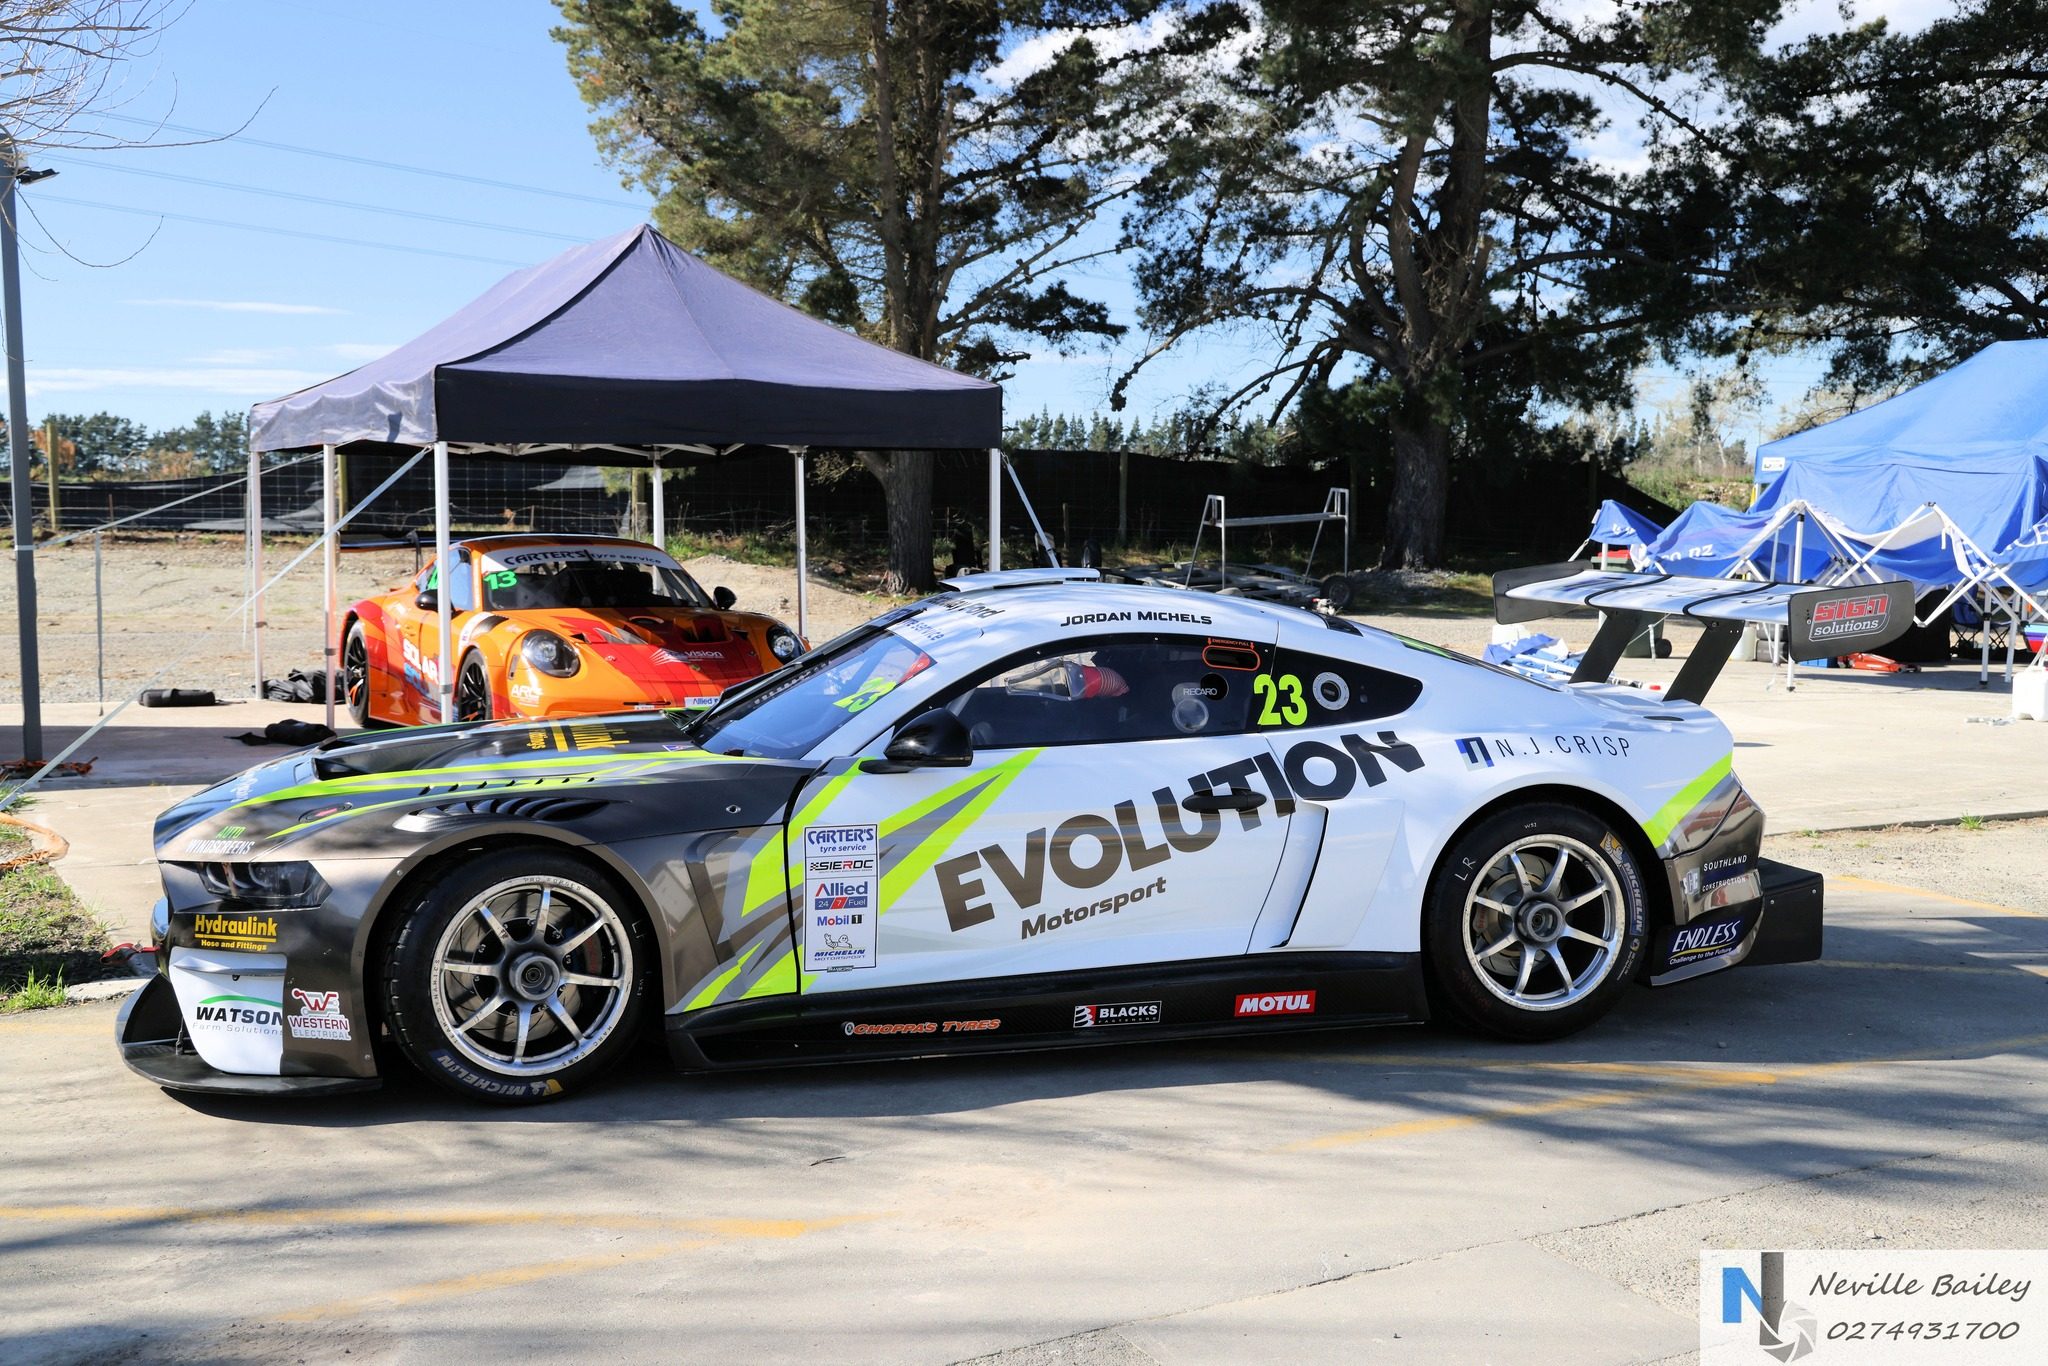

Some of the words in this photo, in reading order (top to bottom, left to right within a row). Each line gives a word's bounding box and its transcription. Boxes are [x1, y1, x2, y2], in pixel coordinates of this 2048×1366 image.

[504, 550, 587, 566] CARTER'S
[620, 555, 662, 564] service
[484, 571, 518, 590] 13
[1060, 612, 1132, 627] JORDAN
[1137, 611, 1213, 625] MICHELS
[1814, 619, 1879, 636] solutions
[1183, 687, 1218, 696] RECARO
[1253, 673, 1309, 726] 23
[216, 826, 247, 840] AUTO
[807, 828, 874, 845] CARTER'S
[934, 730, 1426, 932] EVOLUTION
[186, 839, 256, 855] WINDSCREENS
[820, 845, 837, 853] tyre
[838, 844, 867, 852] service
[815, 859, 874, 871] SIEROC
[1703, 855, 1748, 872] SOUTHLAND
[815, 881, 868, 896] Allied
[1702, 876, 1746, 892] CONSTRUCTION
[818, 900, 829, 908] 24
[848, 899, 866, 907] Fuel
[1624, 862, 1643, 933] MICHELIN
[1021, 876, 1167, 939] Motorsport
[195, 914, 278, 936] Hydraulink
[817, 914, 850, 926] Mobil
[1672, 920, 1741, 953] ENDLESS
[201, 939, 220, 947] Hose
[236, 940, 267, 951] Fittings
[814, 949, 866, 957] MICHELIN
[1669, 953, 1697, 965] Challenge
[1704, 950, 1714, 958] the
[1715, 947, 1733, 956] Future
[1099, 1005, 1158, 1017] BLACKS
[1239, 994, 1311, 1013] MOTUL
[196, 1006, 283, 1026] WATSON
[290, 1017, 349, 1031] WESTERN
[192, 1022, 221, 1031] Farm
[942, 1019, 1001, 1031] TYRES
[293, 1029, 350, 1040] ELECTRICAL
[437, 1055, 527, 1095] MICHELIN
